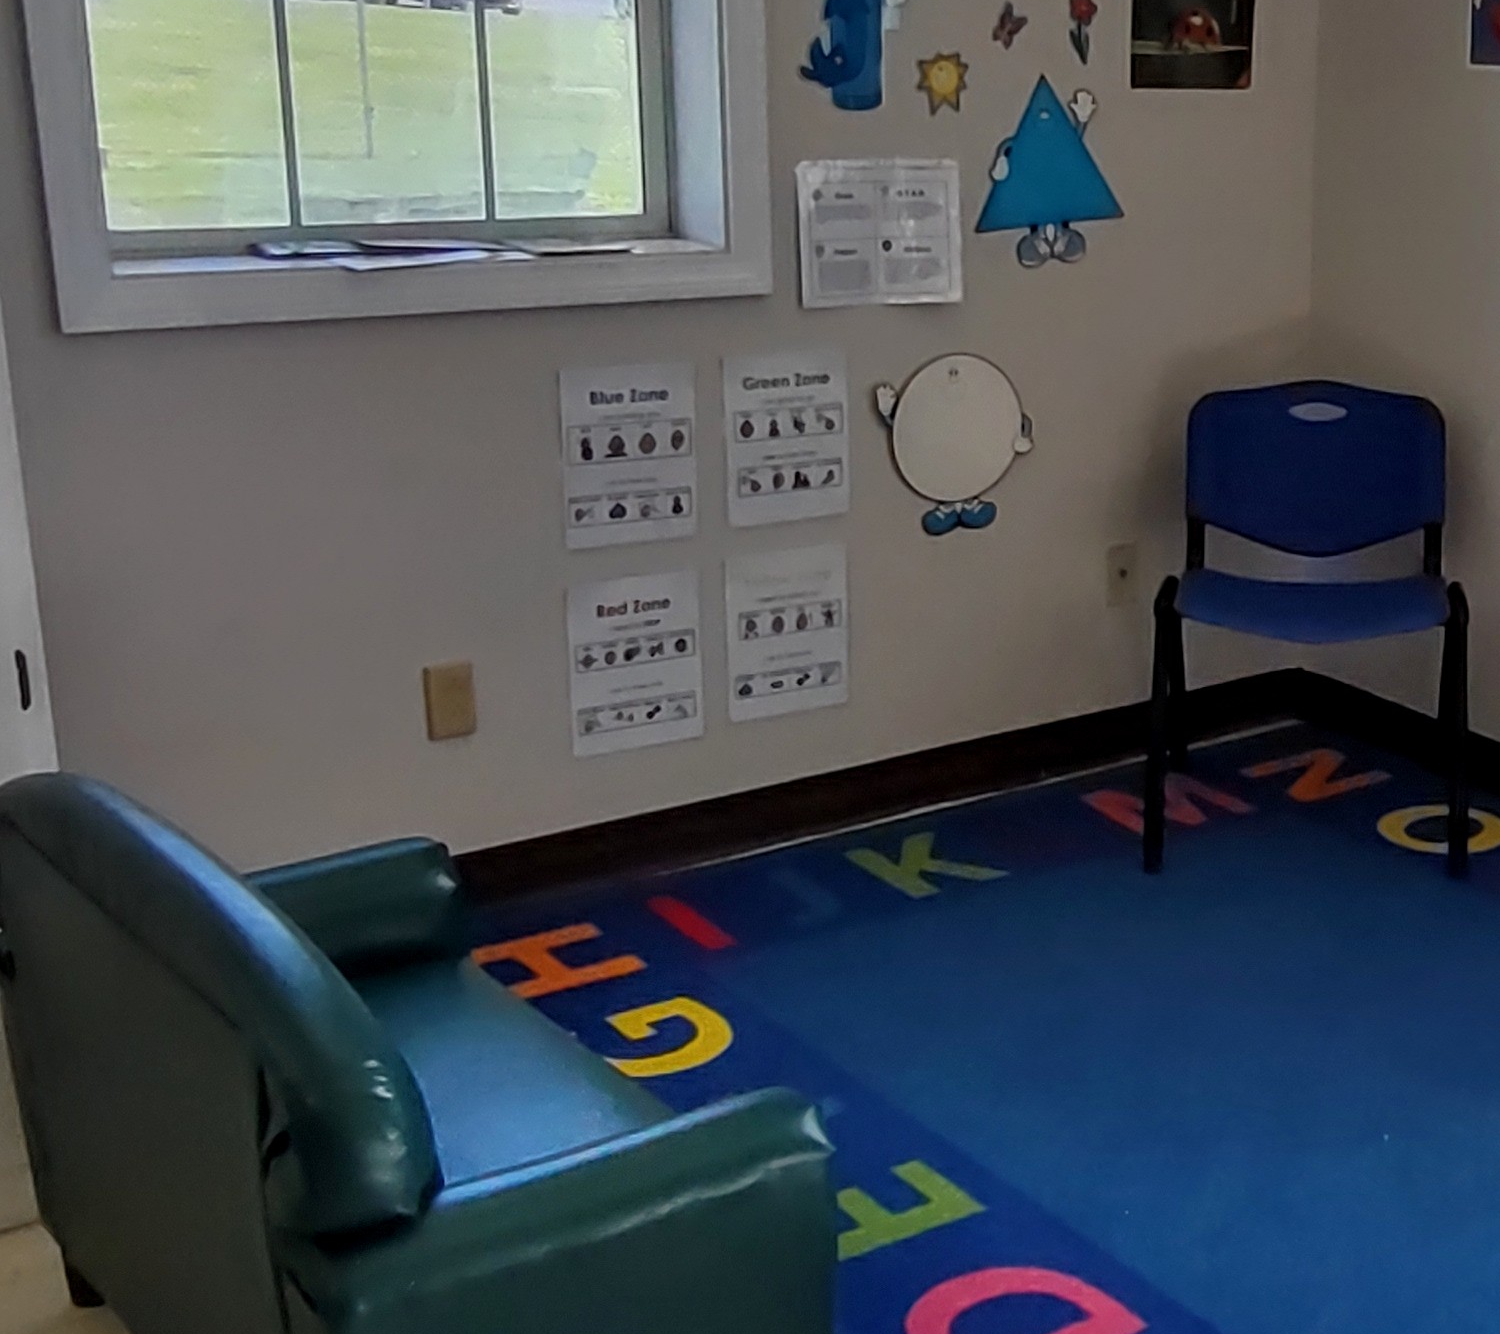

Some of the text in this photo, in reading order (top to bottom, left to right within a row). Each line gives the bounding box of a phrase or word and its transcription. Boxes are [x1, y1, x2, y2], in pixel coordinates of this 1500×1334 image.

[589, 387, 670, 406] Blue Zone
[741, 371, 831, 391] Green Zone
[596, 597, 671, 618] Red Zone
[845, 831, 1009, 899] K
[470, 923, 648, 999] H
[603, 996, 734, 1079] G
